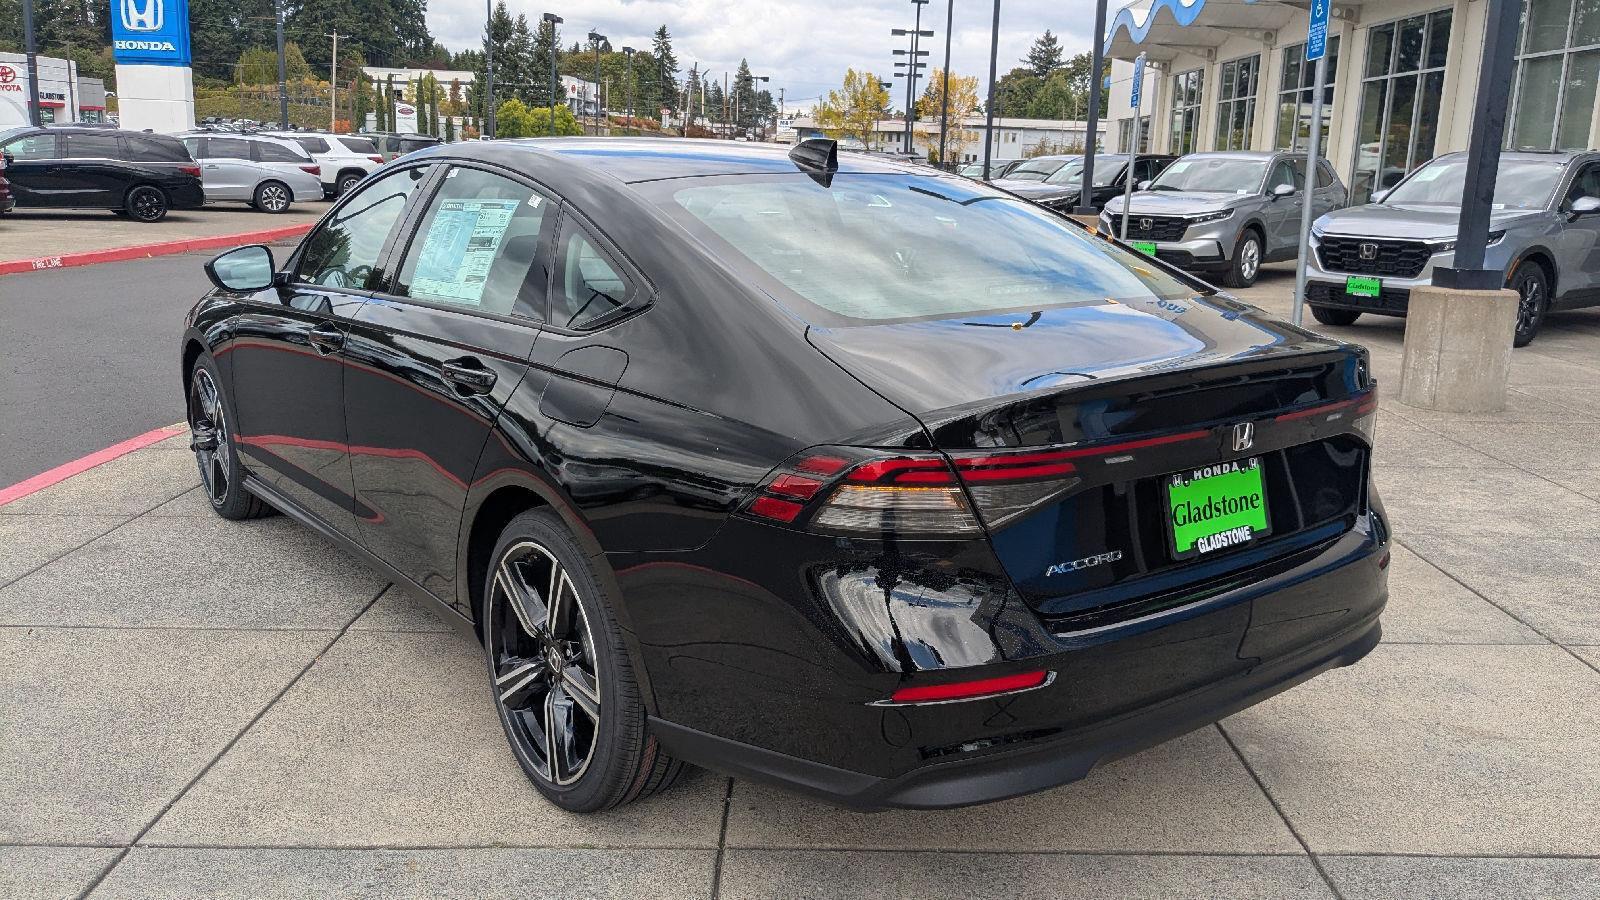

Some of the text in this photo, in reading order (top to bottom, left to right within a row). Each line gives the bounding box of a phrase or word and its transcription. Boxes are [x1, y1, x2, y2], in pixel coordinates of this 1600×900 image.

[115, 41, 176, 51] HONDA
[1193, 462, 1239, 480] HONDA
[1173, 492, 1260, 526] Gladstone
[1197, 525, 1252, 553] GLADSTONE
[1045, 550, 1122, 577] ACCORD
